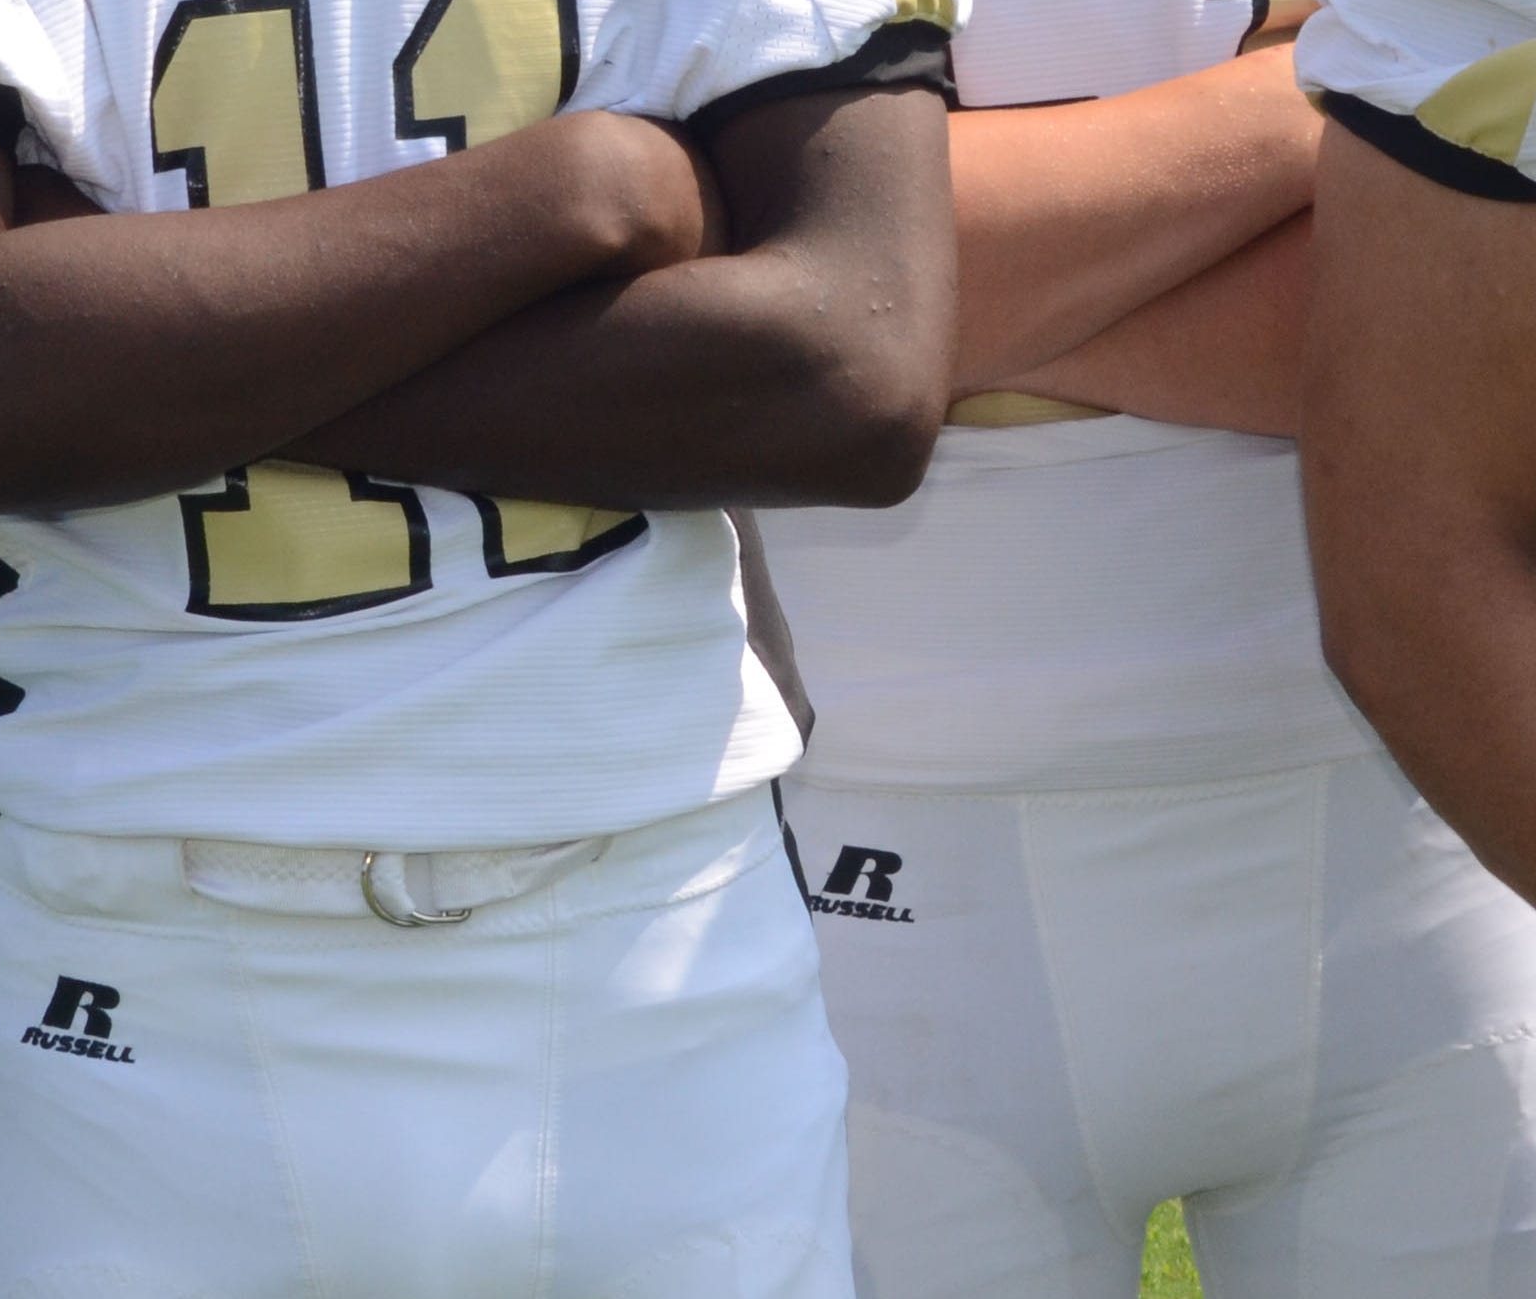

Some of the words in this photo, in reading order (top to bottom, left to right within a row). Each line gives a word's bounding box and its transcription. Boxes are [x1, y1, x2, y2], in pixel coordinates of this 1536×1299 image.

[822, 845, 902, 902] R
[809, 895, 914, 923] RUSSELL
[42, 975, 120, 1039] R
[21, 1027, 136, 1063] RUSSELL
